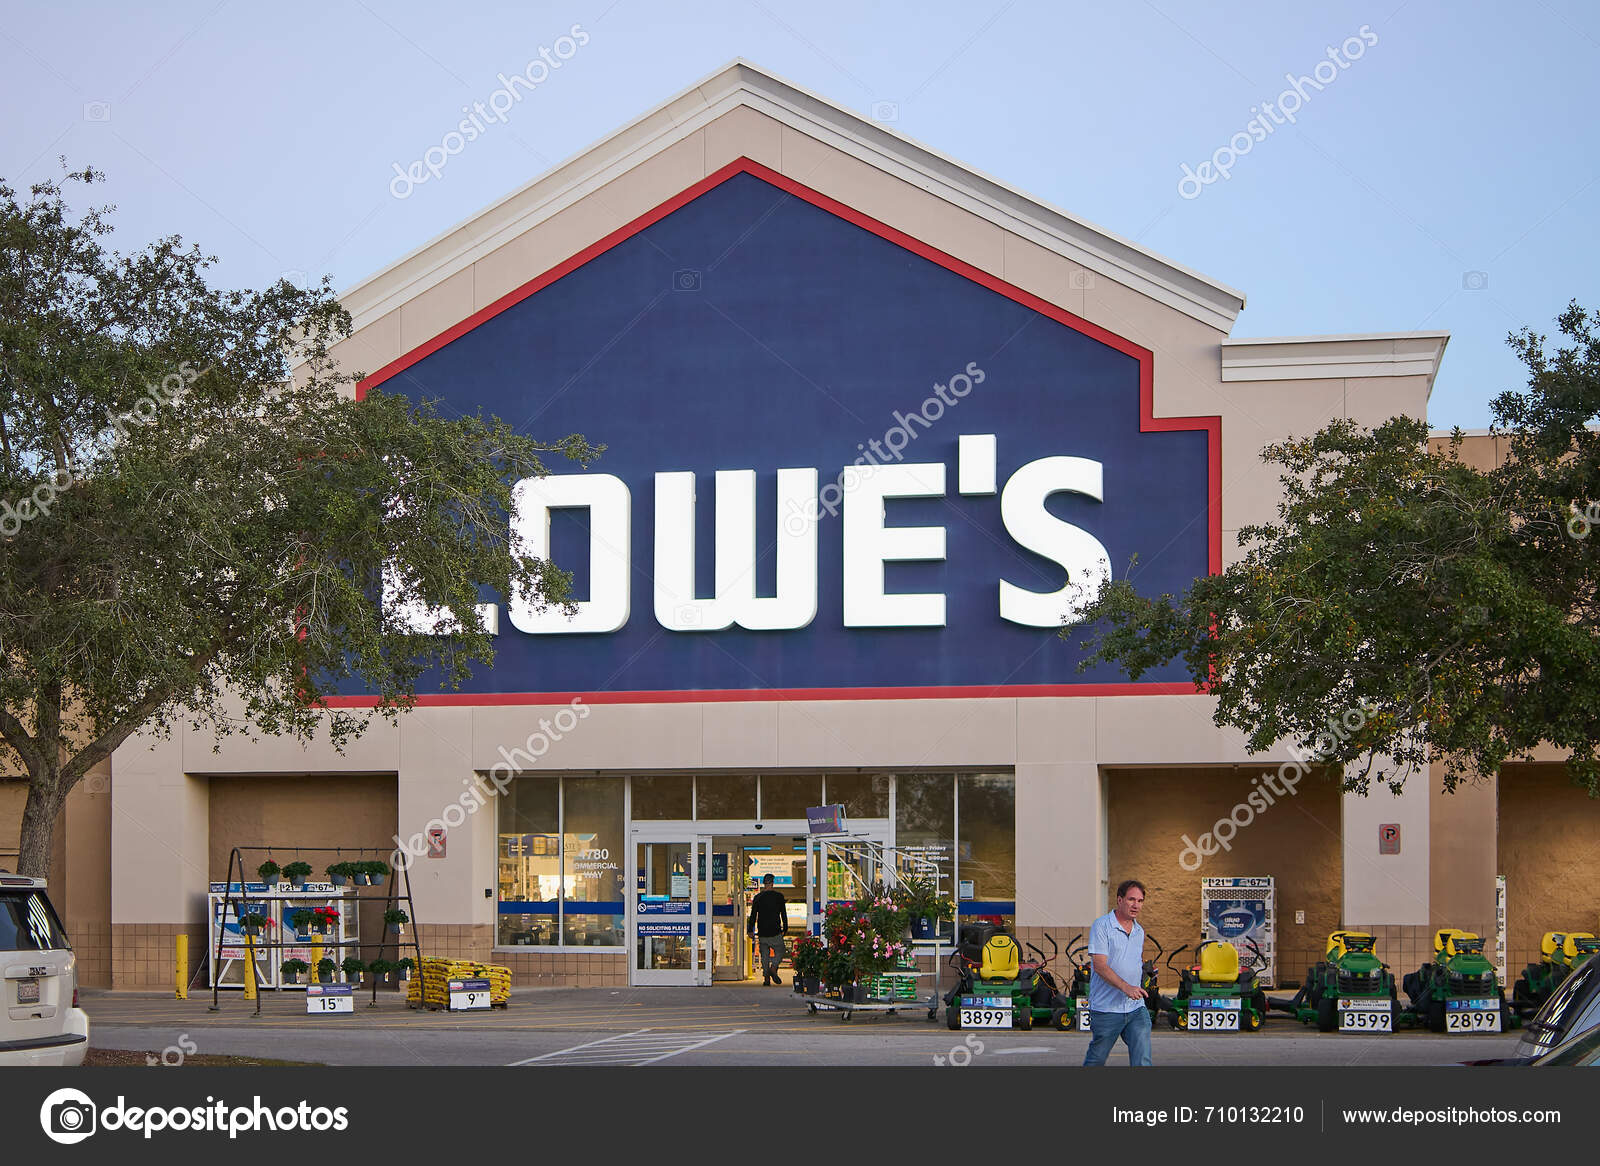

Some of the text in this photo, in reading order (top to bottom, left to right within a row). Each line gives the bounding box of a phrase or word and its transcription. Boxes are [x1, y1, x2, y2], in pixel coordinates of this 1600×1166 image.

[382, 434, 1112, 635] LOWE'S
[568, 862, 618, 870] OMMERCIAL
[583, 871, 603, 880] WAY
[1346, 1013, 1389, 1028] 3599
[1450, 1013, 1495, 1028] 2899
